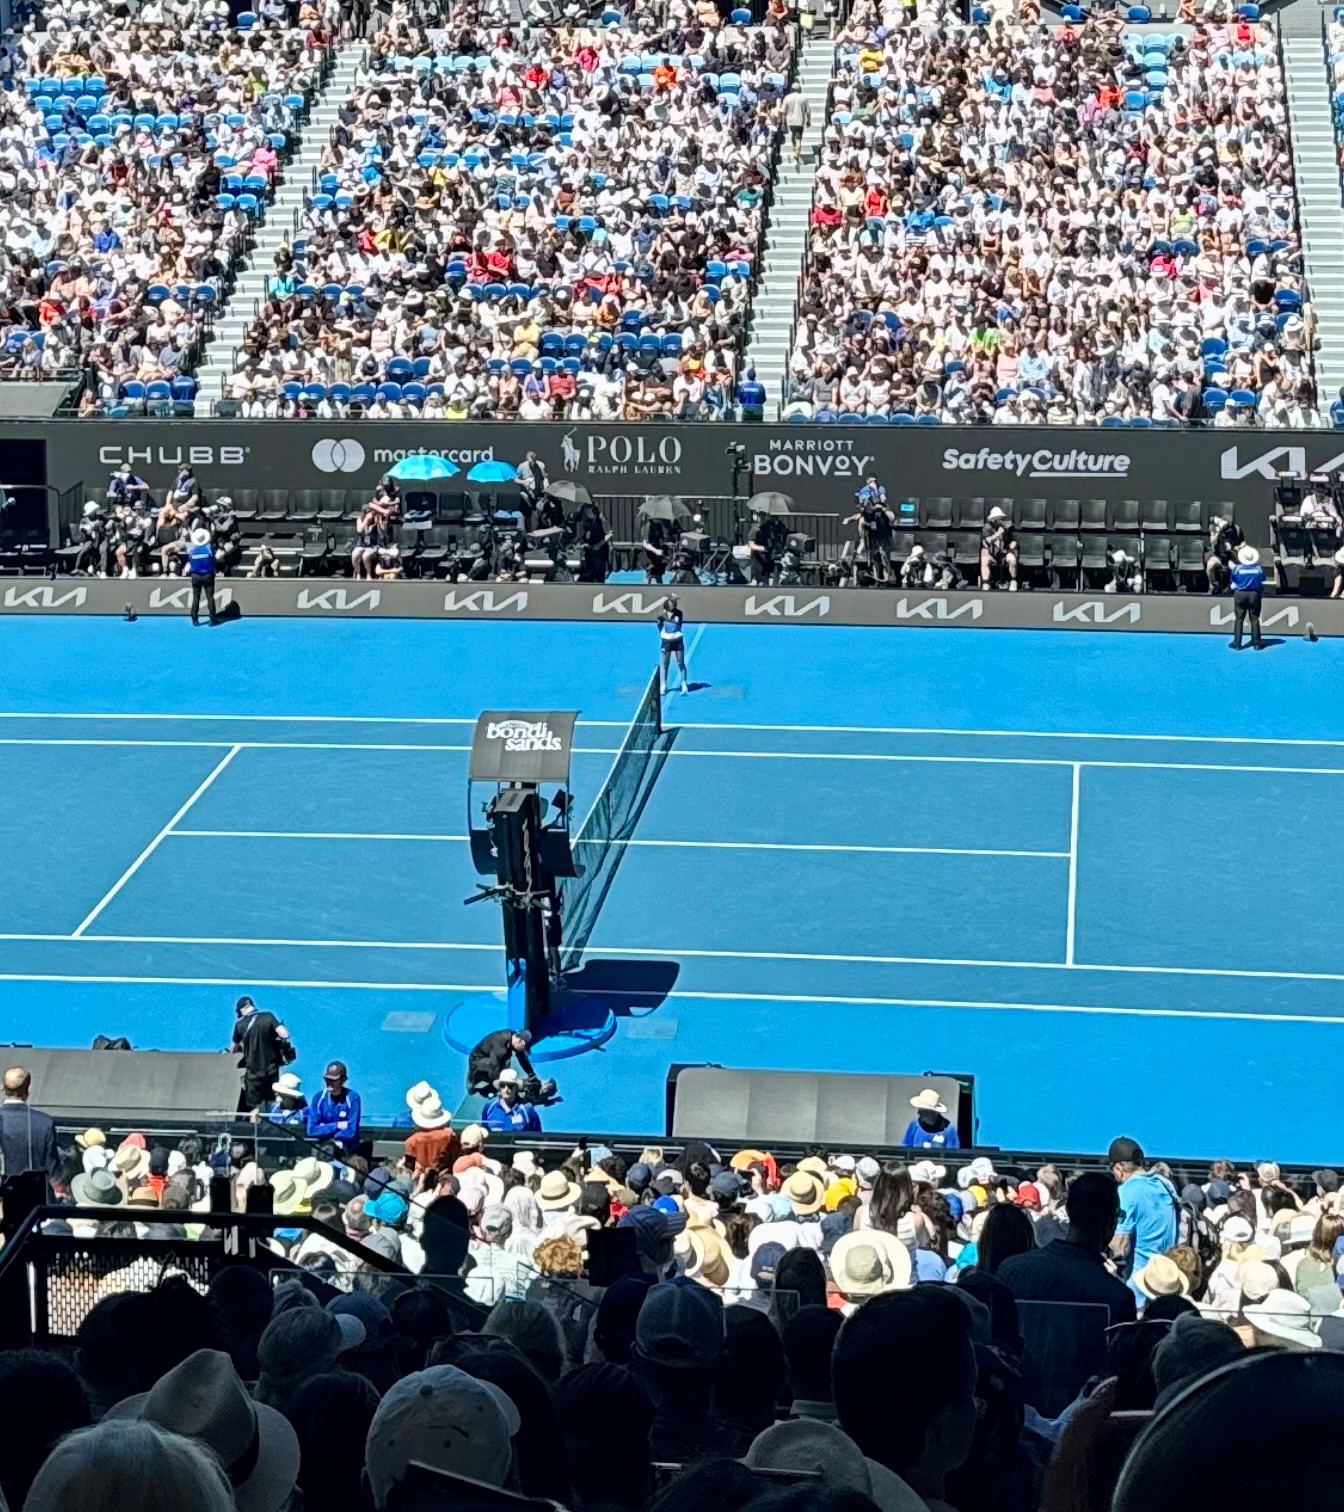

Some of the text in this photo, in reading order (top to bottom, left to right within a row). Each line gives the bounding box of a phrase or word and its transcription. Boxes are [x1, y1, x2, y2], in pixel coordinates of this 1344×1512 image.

[99, 446, 246, 465] CHUBB
[588, 436, 682, 464] POLO
[770, 439, 854, 451] MARRIOTT
[588, 465, 682, 474] RALPH LAUREN
[942, 447, 1132, 477] SafetyCulture
[4, 586, 88, 608] KIA
[297, 589, 381, 610] KIA
[444, 590, 528, 612] KIA
[744, 594, 830, 616] KIA
[896, 598, 984, 620] KIA
[1053, 601, 1141, 624] KIA
[1210, 604, 1300, 628] KA
[486, 722, 548, 738] bondi
[504, 730, 562, 751] sands
